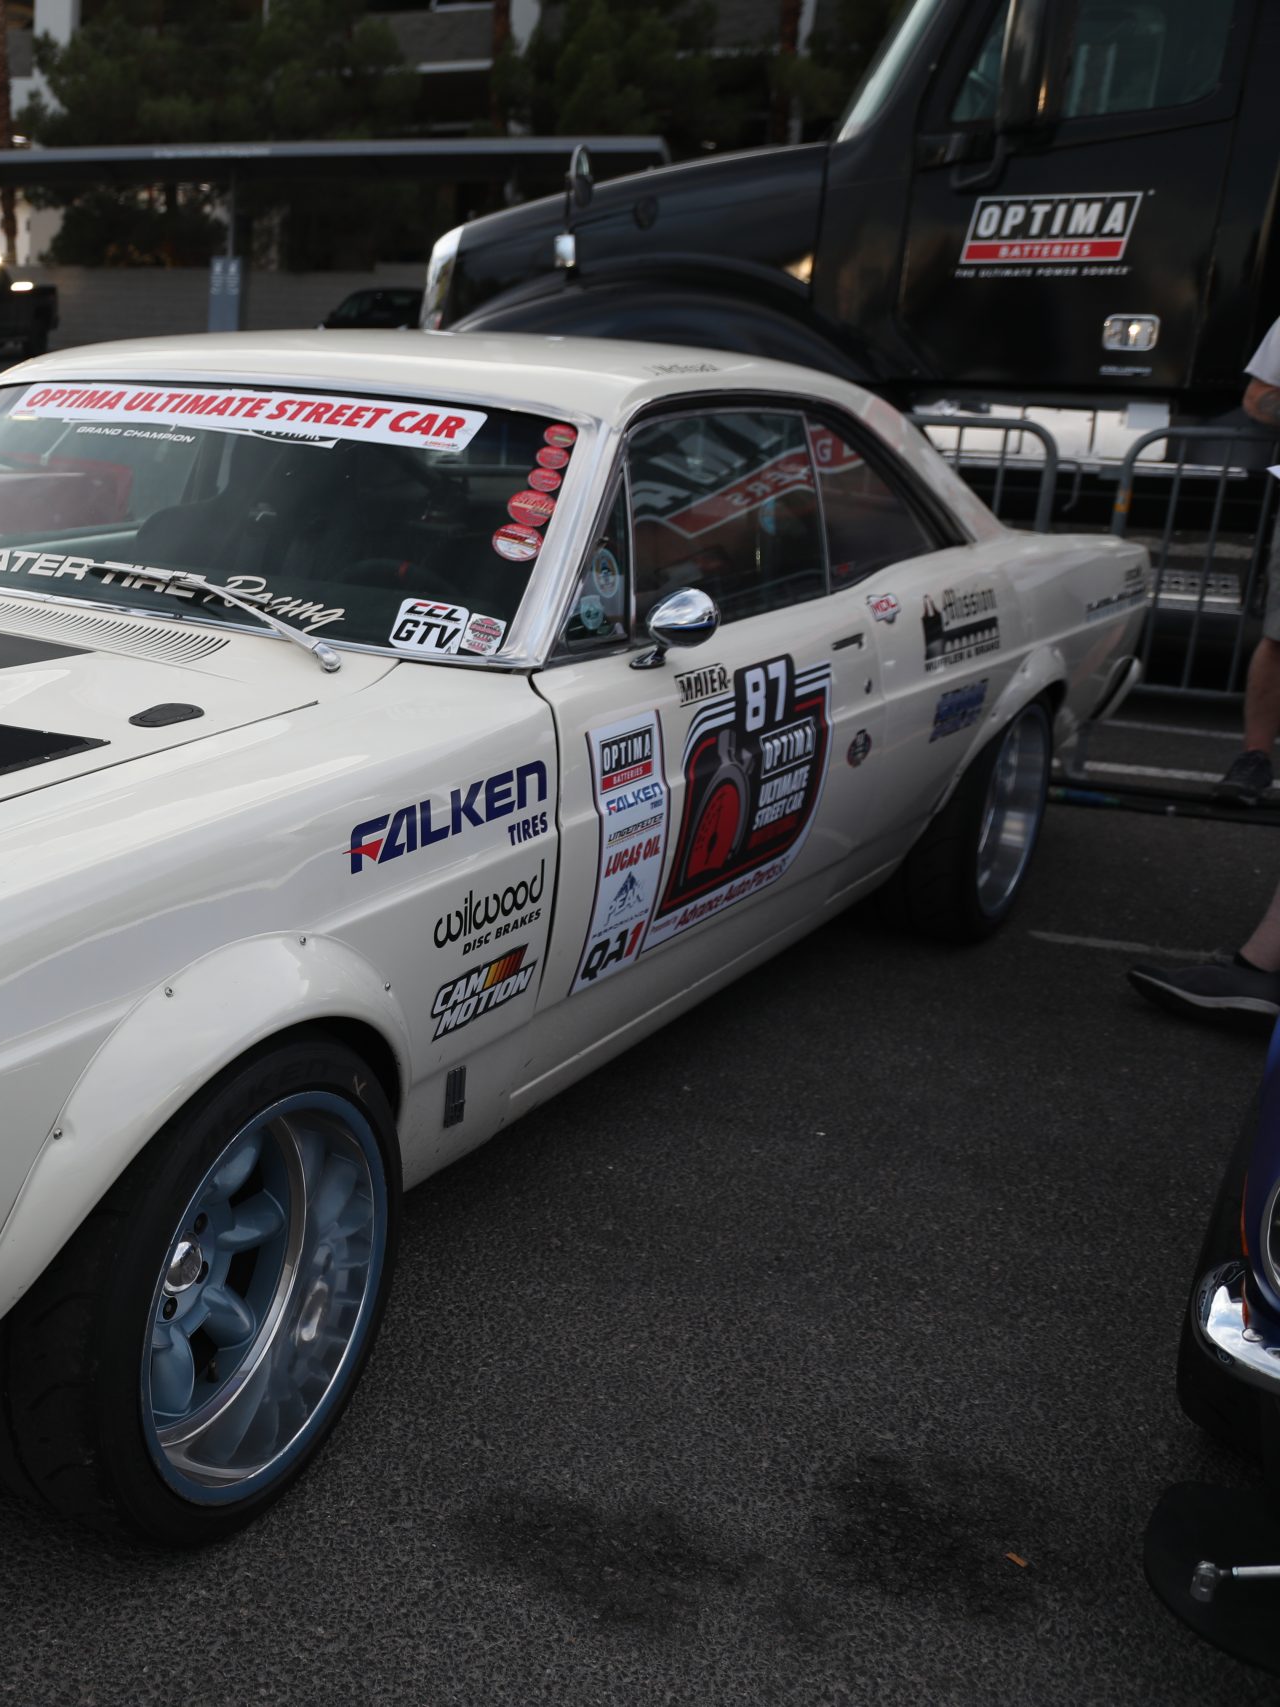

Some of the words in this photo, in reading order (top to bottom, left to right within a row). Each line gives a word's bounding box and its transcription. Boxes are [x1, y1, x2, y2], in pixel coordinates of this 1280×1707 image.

[976, 202, 1127, 238] OPTIMA
[998, 244, 1092, 258] BATTERIES
[26, 388, 125, 411] OPTIMA
[123, 391, 272, 419] ULTIMATE
[265, 399, 393, 429] STREET
[388, 411, 466, 439] CAR
[76, 425, 123, 436] GRAND
[123, 428, 196, 443] CHAMPION
[392, 618, 462, 650] GTV
[744, 660, 788, 733] 87
[603, 733, 651, 772] OPTIMA
[764, 725, 813, 771] OPTIMA
[613, 766, 644, 785] BATTERIES
[758, 765, 811, 808] ULTIMATE
[344, 760, 548, 875] FALKEN
[606, 782, 664, 816] FALKEN
[752, 802, 786, 831] STREET
[785, 789, 806, 816] CAR
[508, 811, 549, 846] TIRES
[608, 813, 664, 843] LINGENFELTER
[604, 843, 643, 879] LUCAS
[642, 834, 661, 861] OIL
[434, 859, 545, 949] wilwood
[463, 932, 492, 956] DISC
[494, 908, 542, 940] BRAKES
[581, 920, 646, 981] QA1
[432, 965, 490, 1016] CAM
[434, 964, 535, 1037] MOTION
